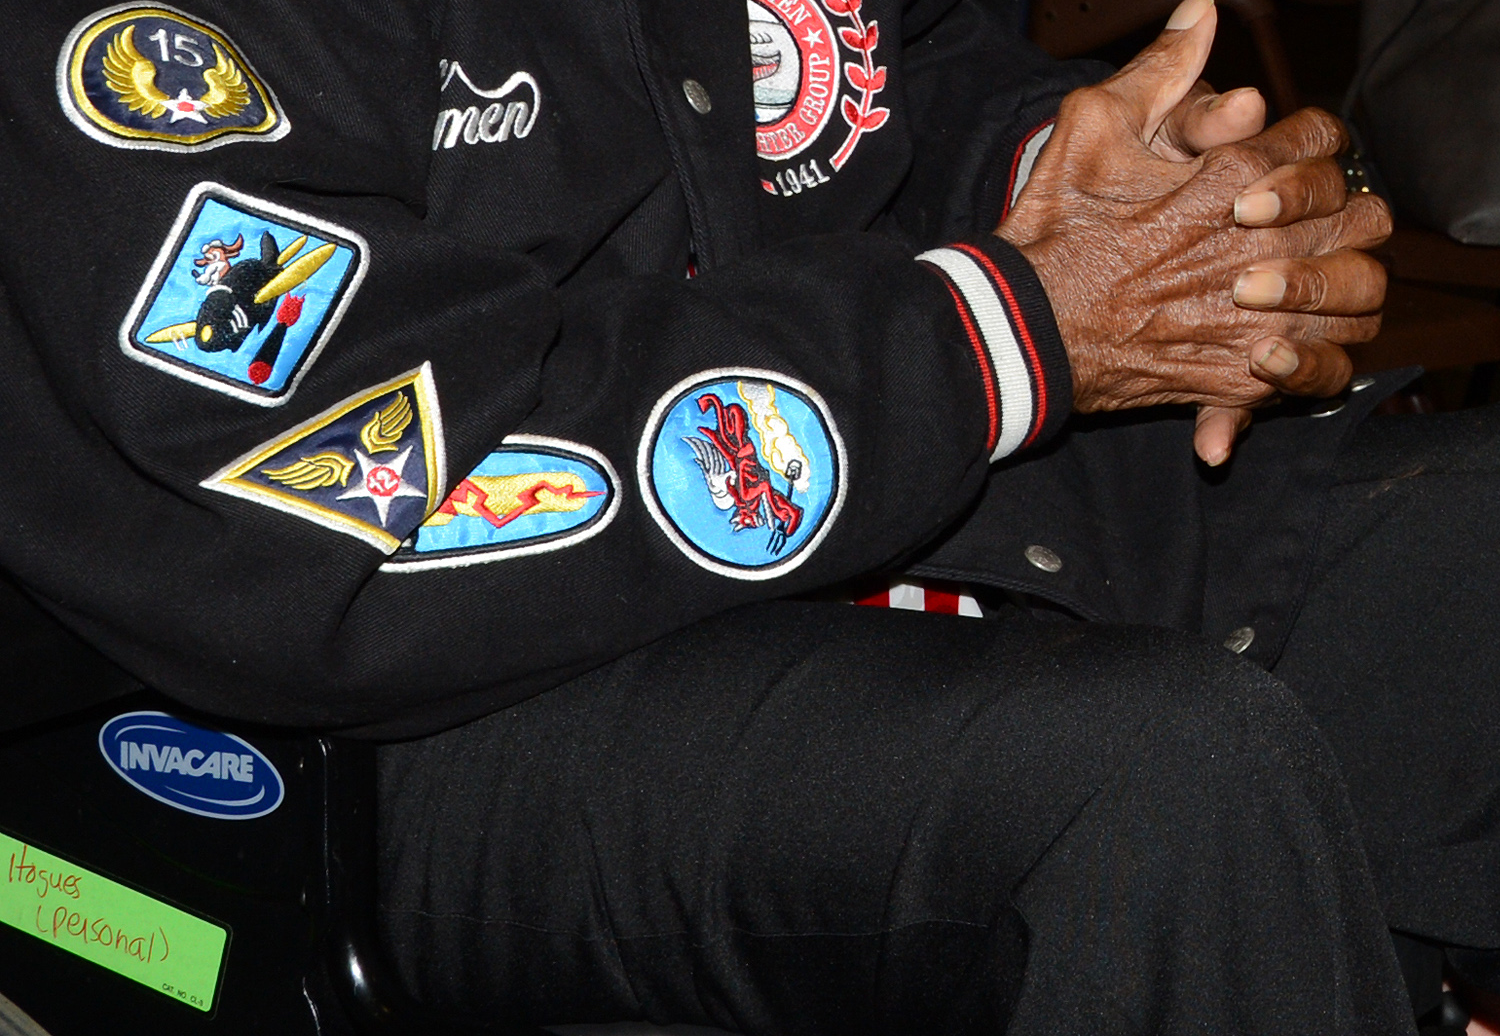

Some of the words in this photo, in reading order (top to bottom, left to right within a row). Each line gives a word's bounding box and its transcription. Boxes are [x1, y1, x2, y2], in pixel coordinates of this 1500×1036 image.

[149, 28, 204, 67] 15
[799, 53, 830, 125] GROUP
[776, 159, 831, 197] 1941
[120, 741, 253, 783] INVACARE
[36, 905, 169, 963] (personal)
